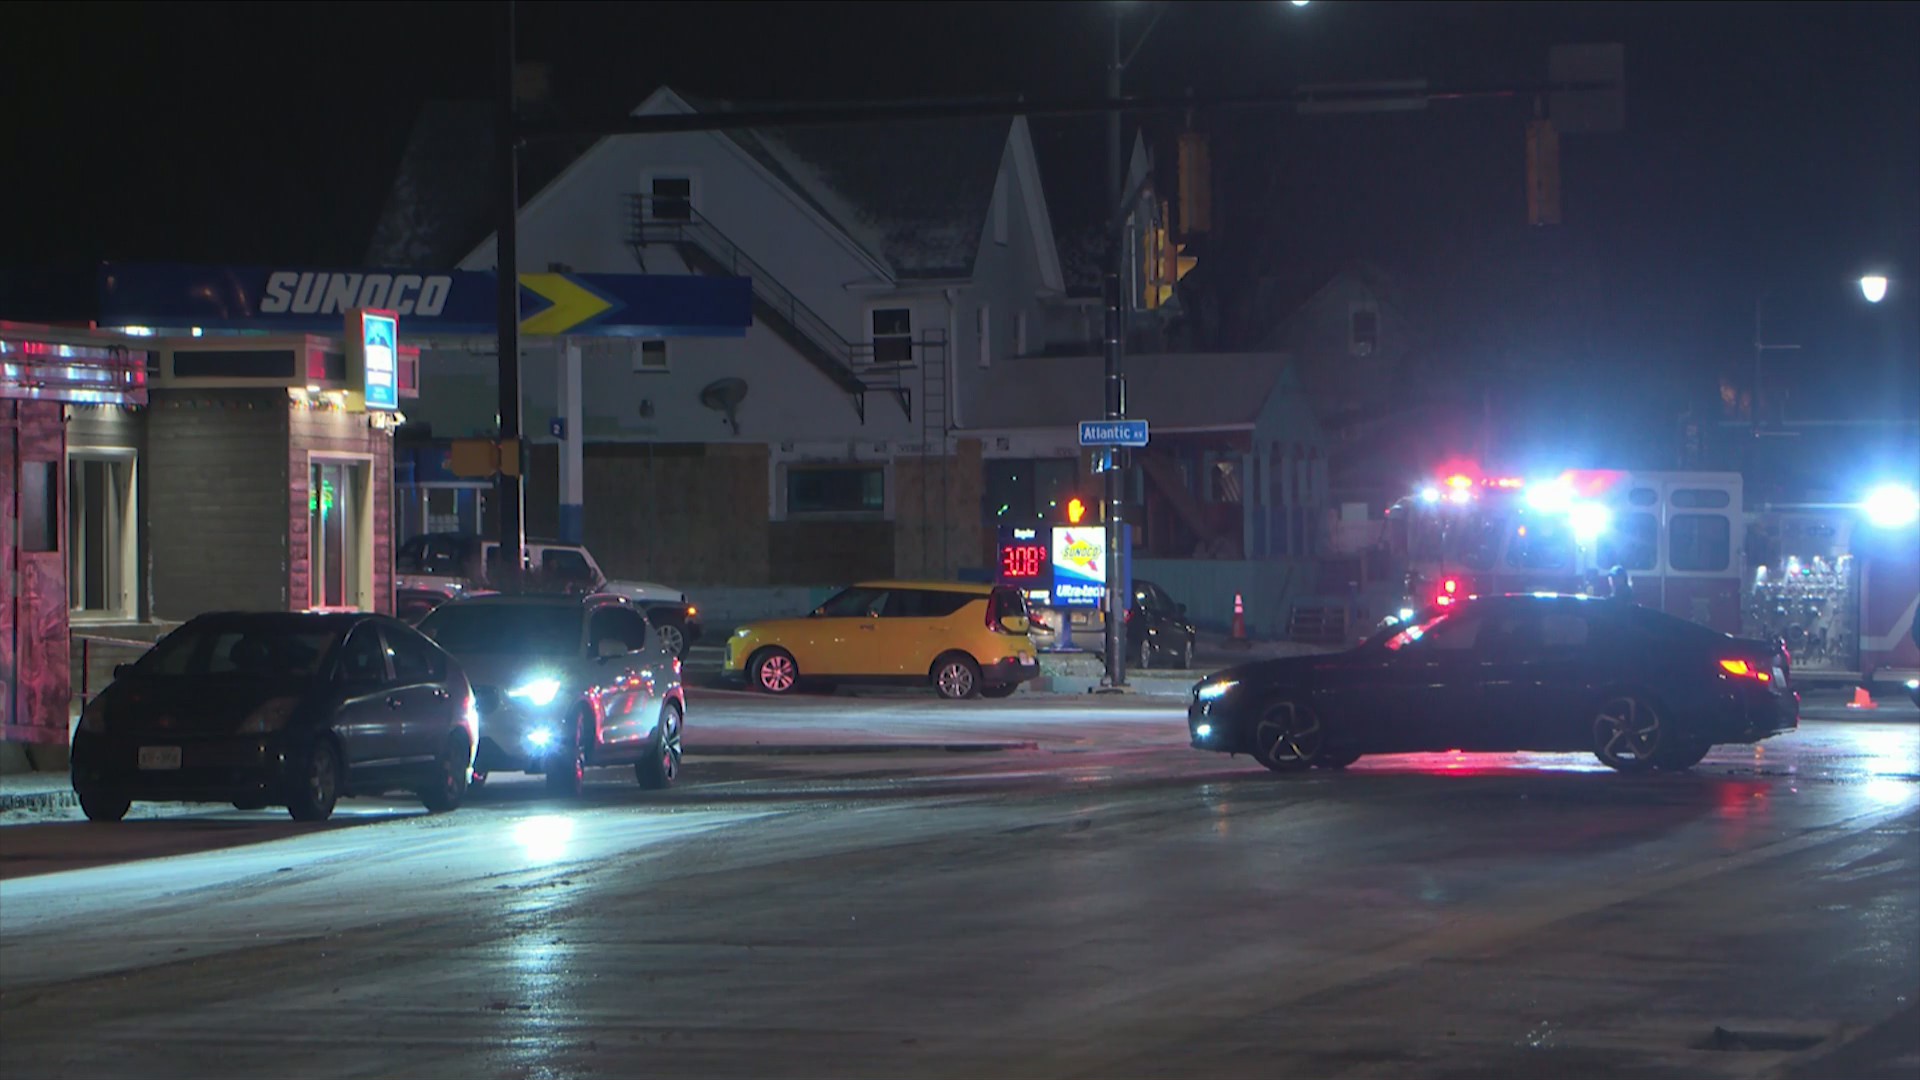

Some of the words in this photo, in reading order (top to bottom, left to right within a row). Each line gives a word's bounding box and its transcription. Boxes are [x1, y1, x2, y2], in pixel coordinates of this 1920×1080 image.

[259, 271, 453, 316] SUNOCO
[1084, 425, 1131, 440] Atlantic
[1063, 546, 1099, 558] SUNOCO
